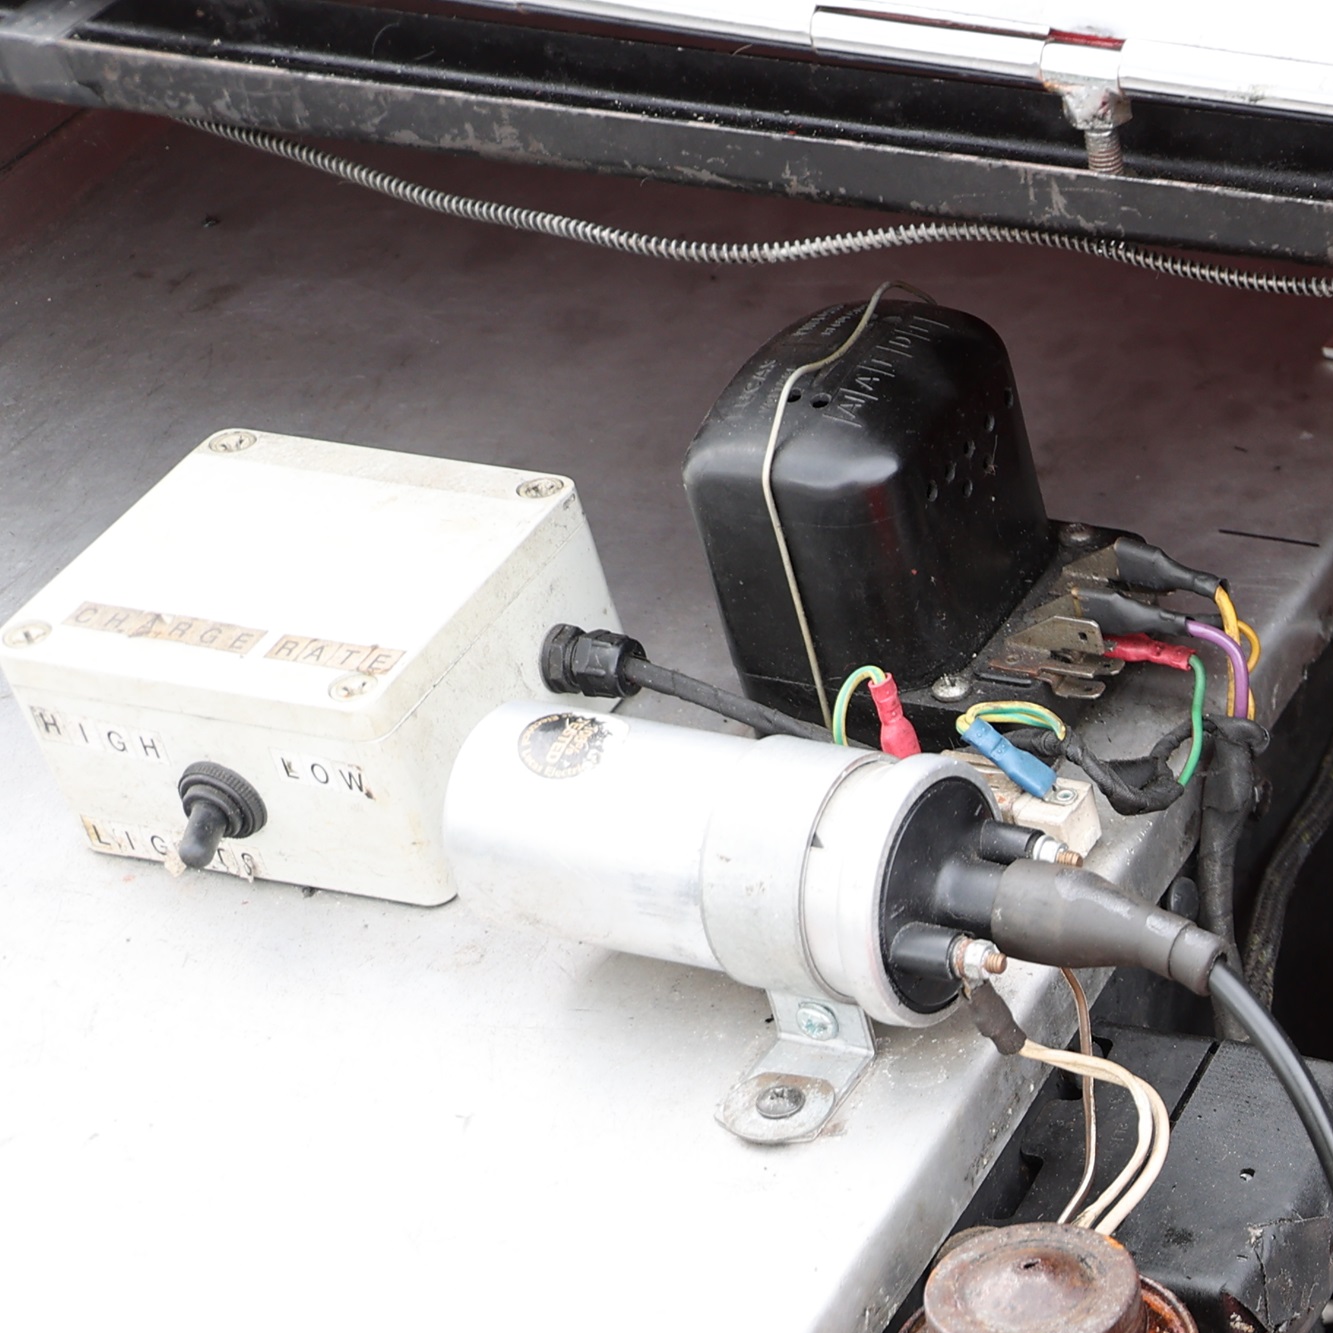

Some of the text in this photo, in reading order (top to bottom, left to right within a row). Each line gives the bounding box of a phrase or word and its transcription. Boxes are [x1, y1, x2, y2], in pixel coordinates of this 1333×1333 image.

[74, 606, 392, 672] CHARGE RATE
[38, 711, 161, 759] HIGH
[280, 756, 366, 794] LOW
[91, 823, 255, 876] LIGTS
